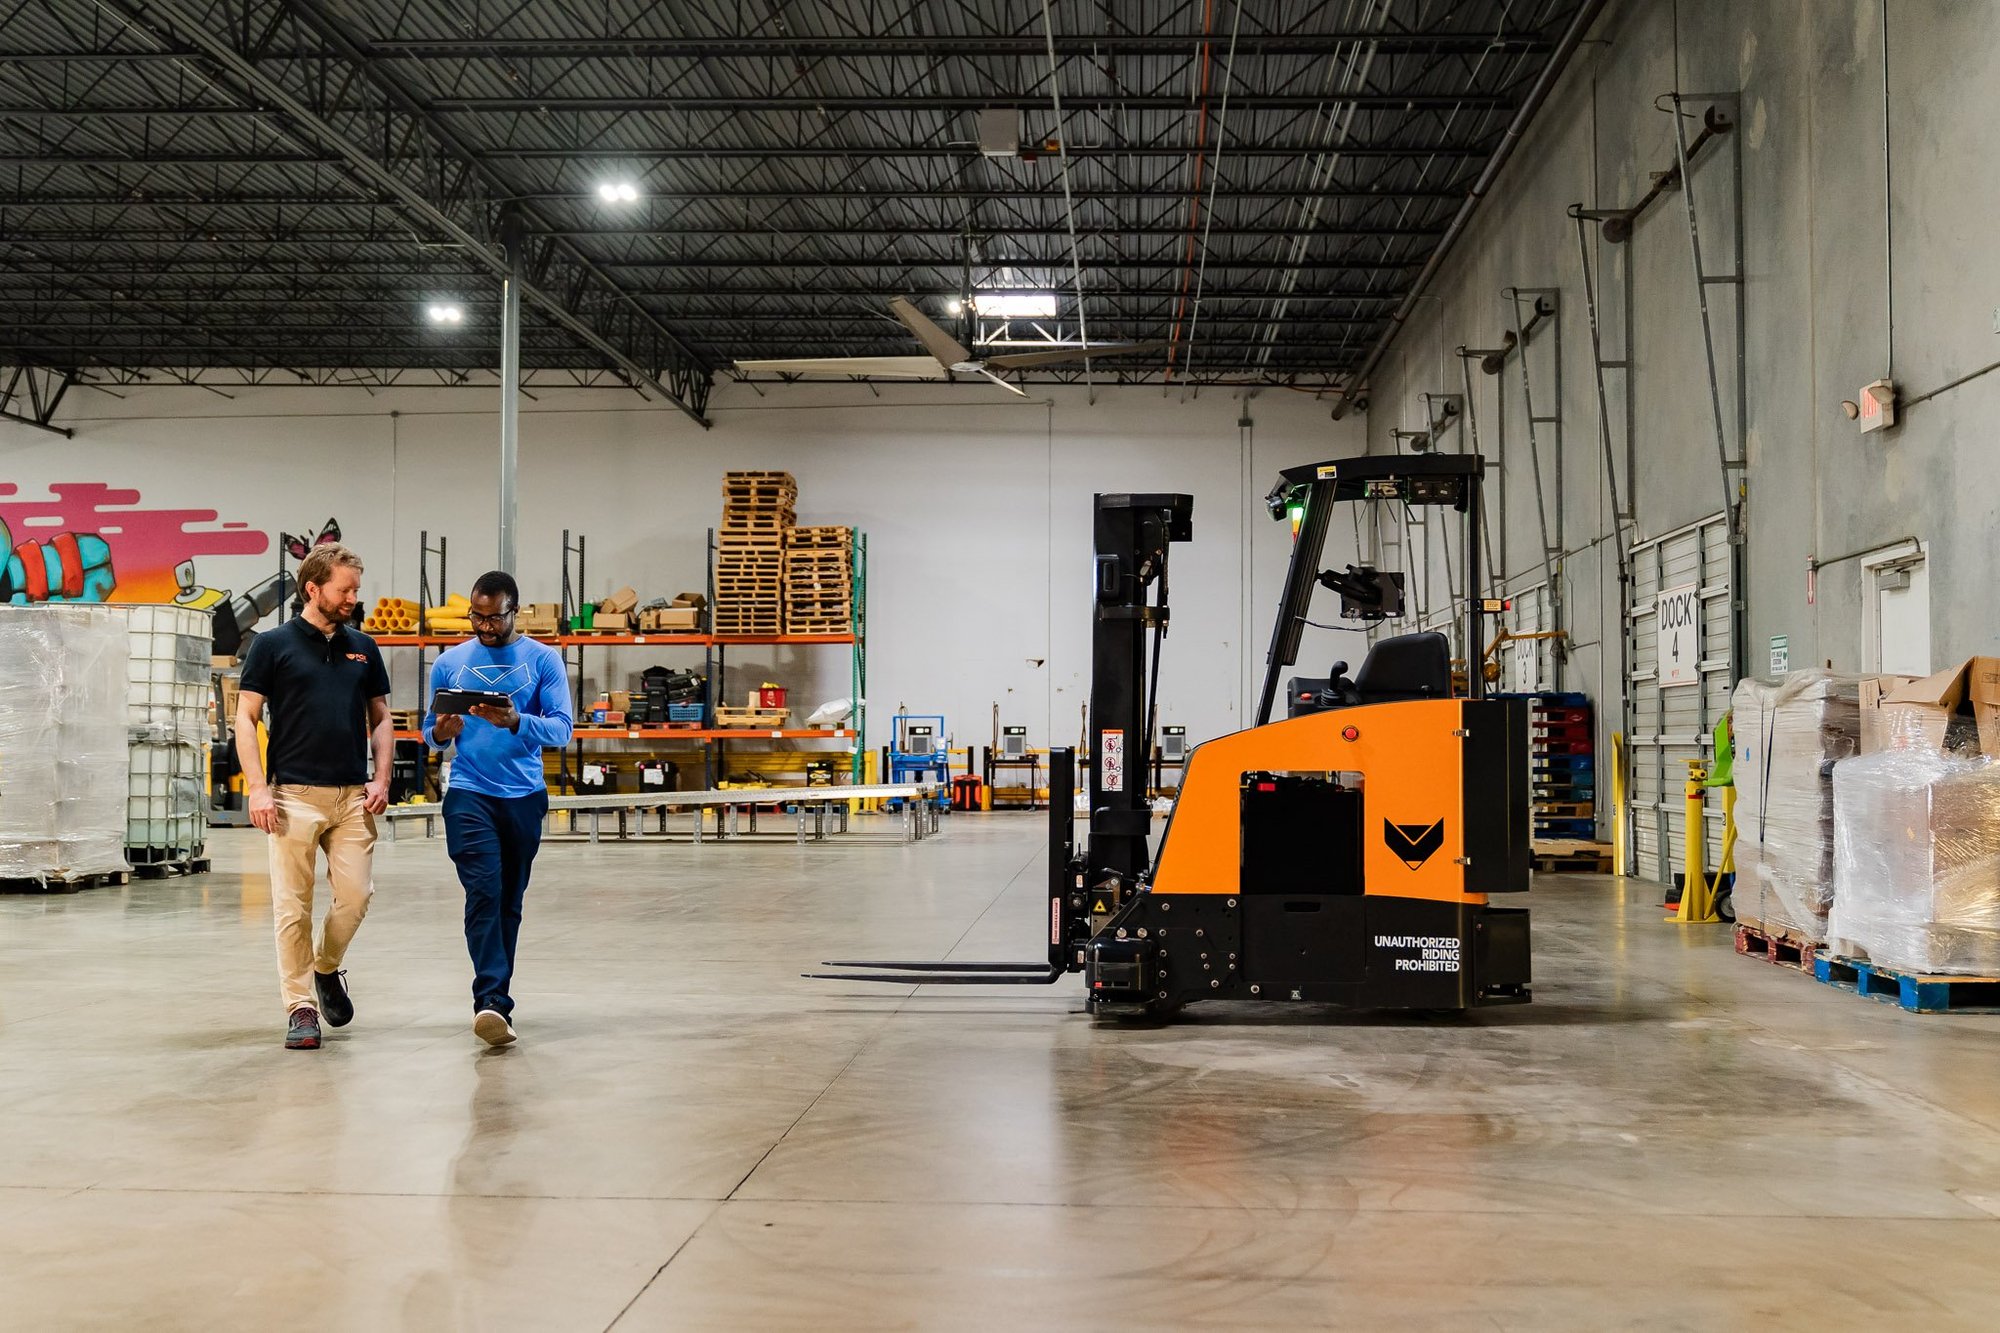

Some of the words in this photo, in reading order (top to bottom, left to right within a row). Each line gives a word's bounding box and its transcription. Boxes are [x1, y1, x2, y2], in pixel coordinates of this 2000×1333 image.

[1662, 592, 1692, 630] DOCK
[1672, 631, 1679, 663] 4
[1522, 661, 1528, 684] 3
[1374, 935, 1460, 948] UNAUTHORIZED
[1422, 948, 1460, 960] RIDING
[1395, 959, 1460, 971] PROHIBITED
